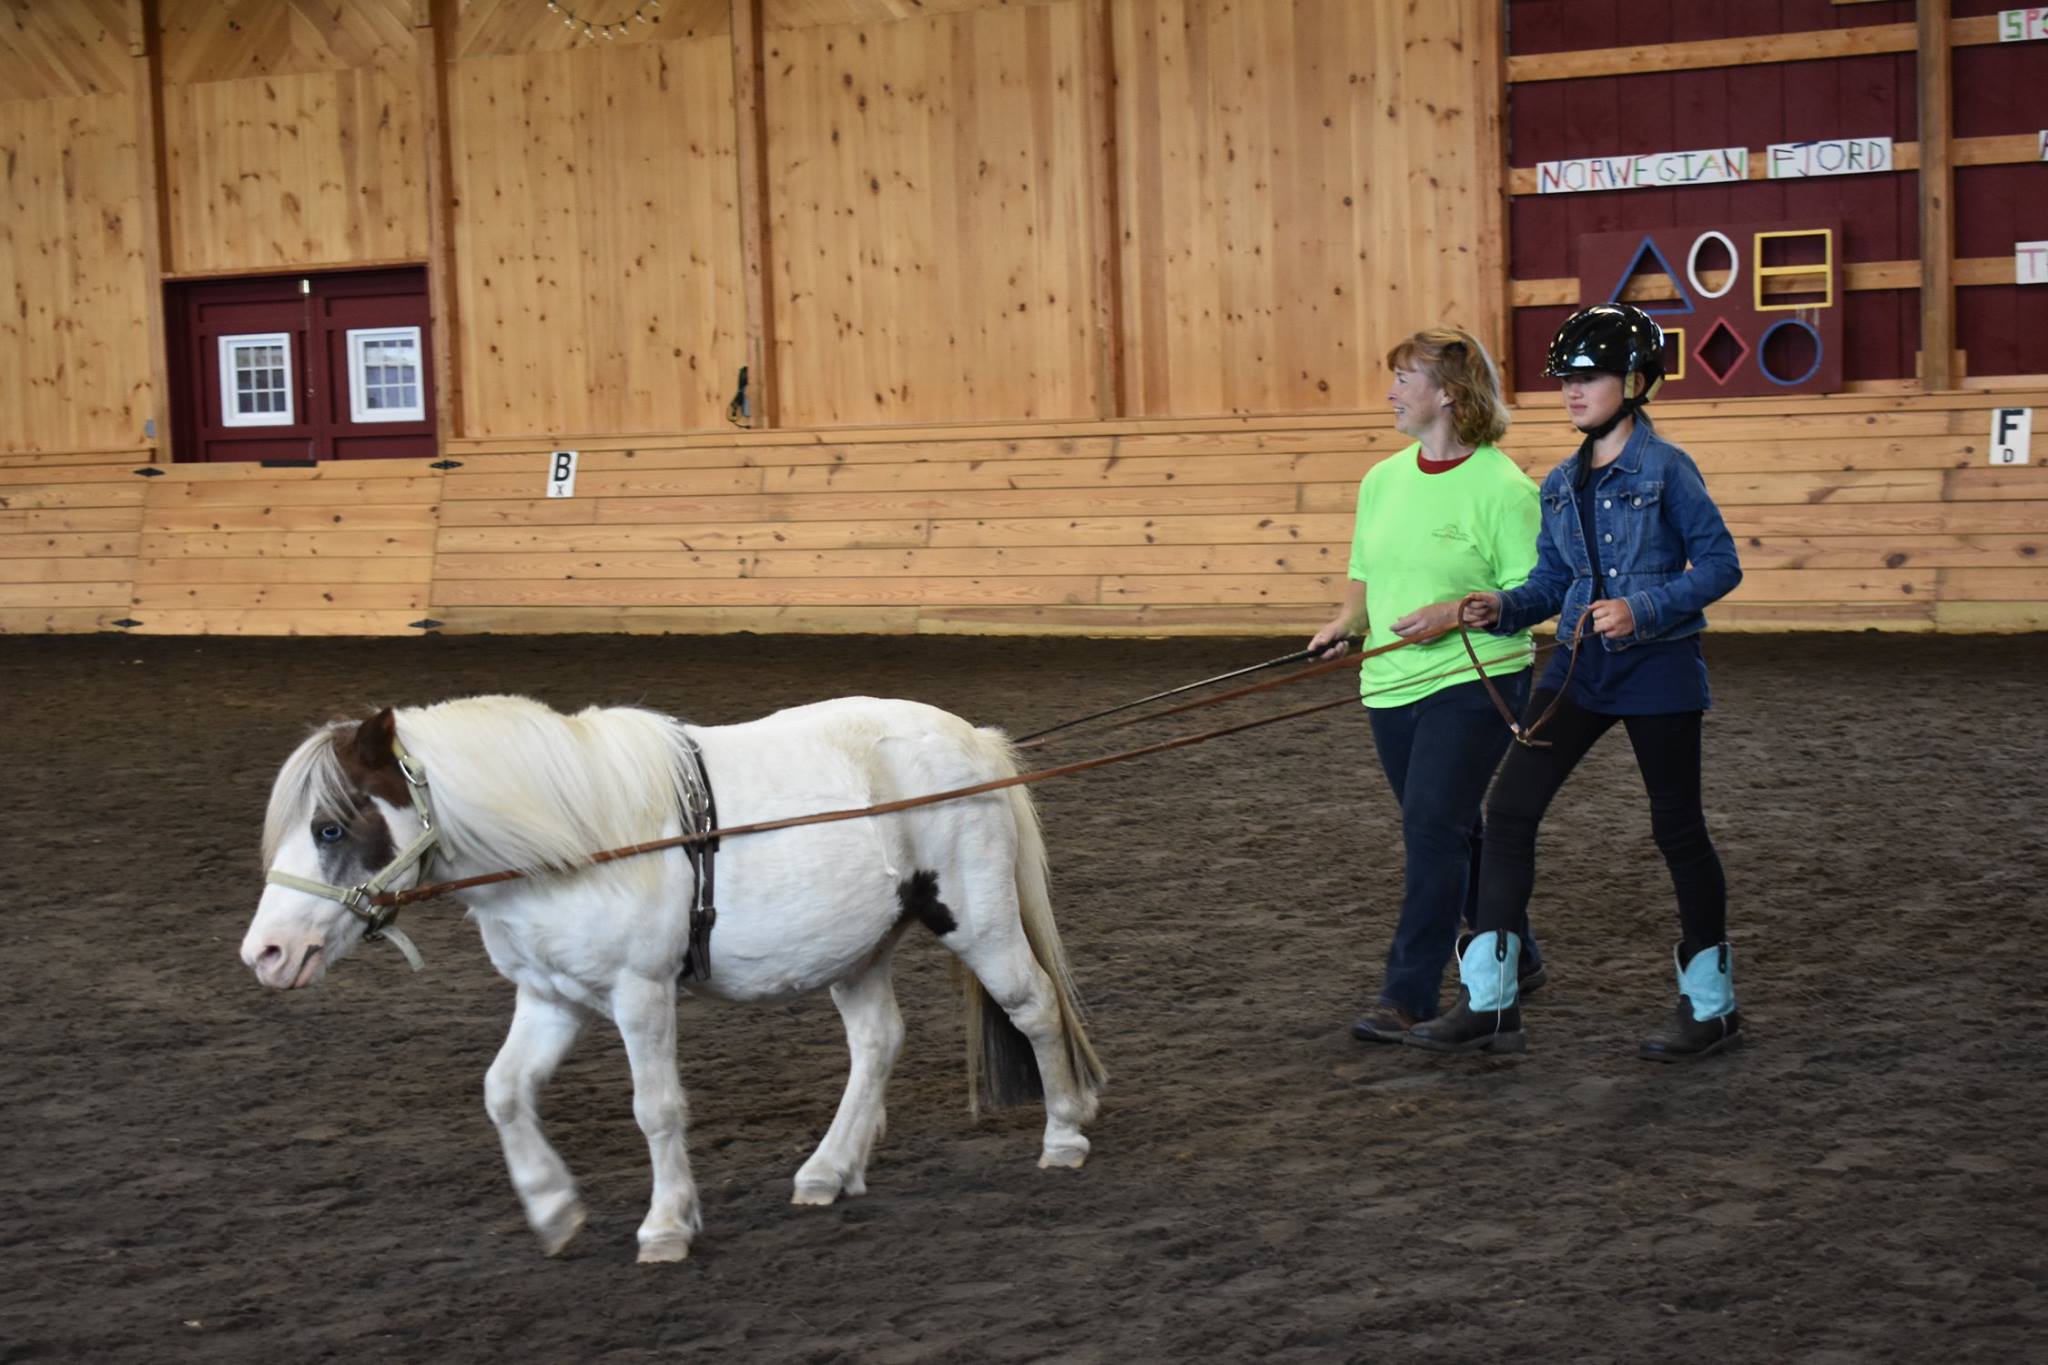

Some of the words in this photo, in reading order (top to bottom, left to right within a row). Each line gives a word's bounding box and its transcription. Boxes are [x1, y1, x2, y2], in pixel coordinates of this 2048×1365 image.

[1541, 150, 1745, 193] NORWEGIAN
[1773, 140, 1885, 178] FJORD
[1999, 409, 2024, 445] F
[554, 452, 571, 481] B
